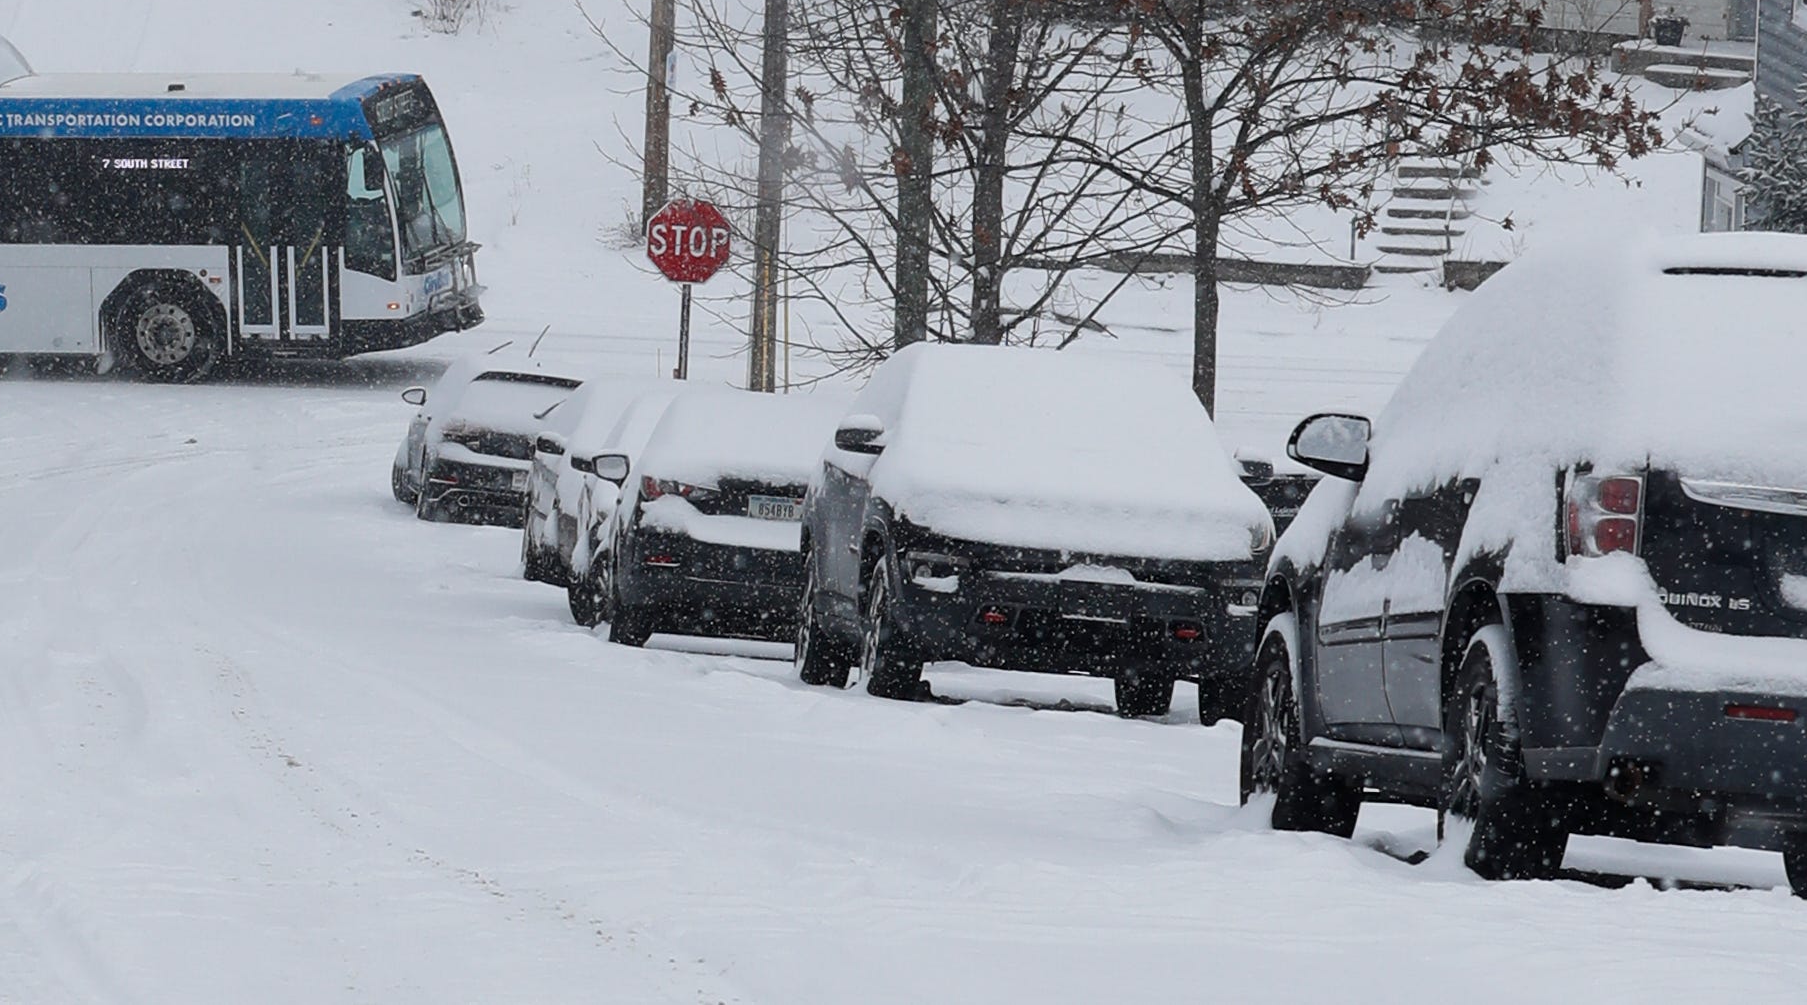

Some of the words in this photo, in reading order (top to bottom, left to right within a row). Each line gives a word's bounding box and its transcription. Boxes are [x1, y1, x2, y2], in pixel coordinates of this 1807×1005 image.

[6, 113, 140, 127] TRANSPORTATION
[144, 113, 255, 127] CORPORATION
[102, 158, 111, 169] 7
[114, 158, 148, 169] SOUTH
[151, 158, 190, 169] STREET
[650, 223, 728, 258] STOP
